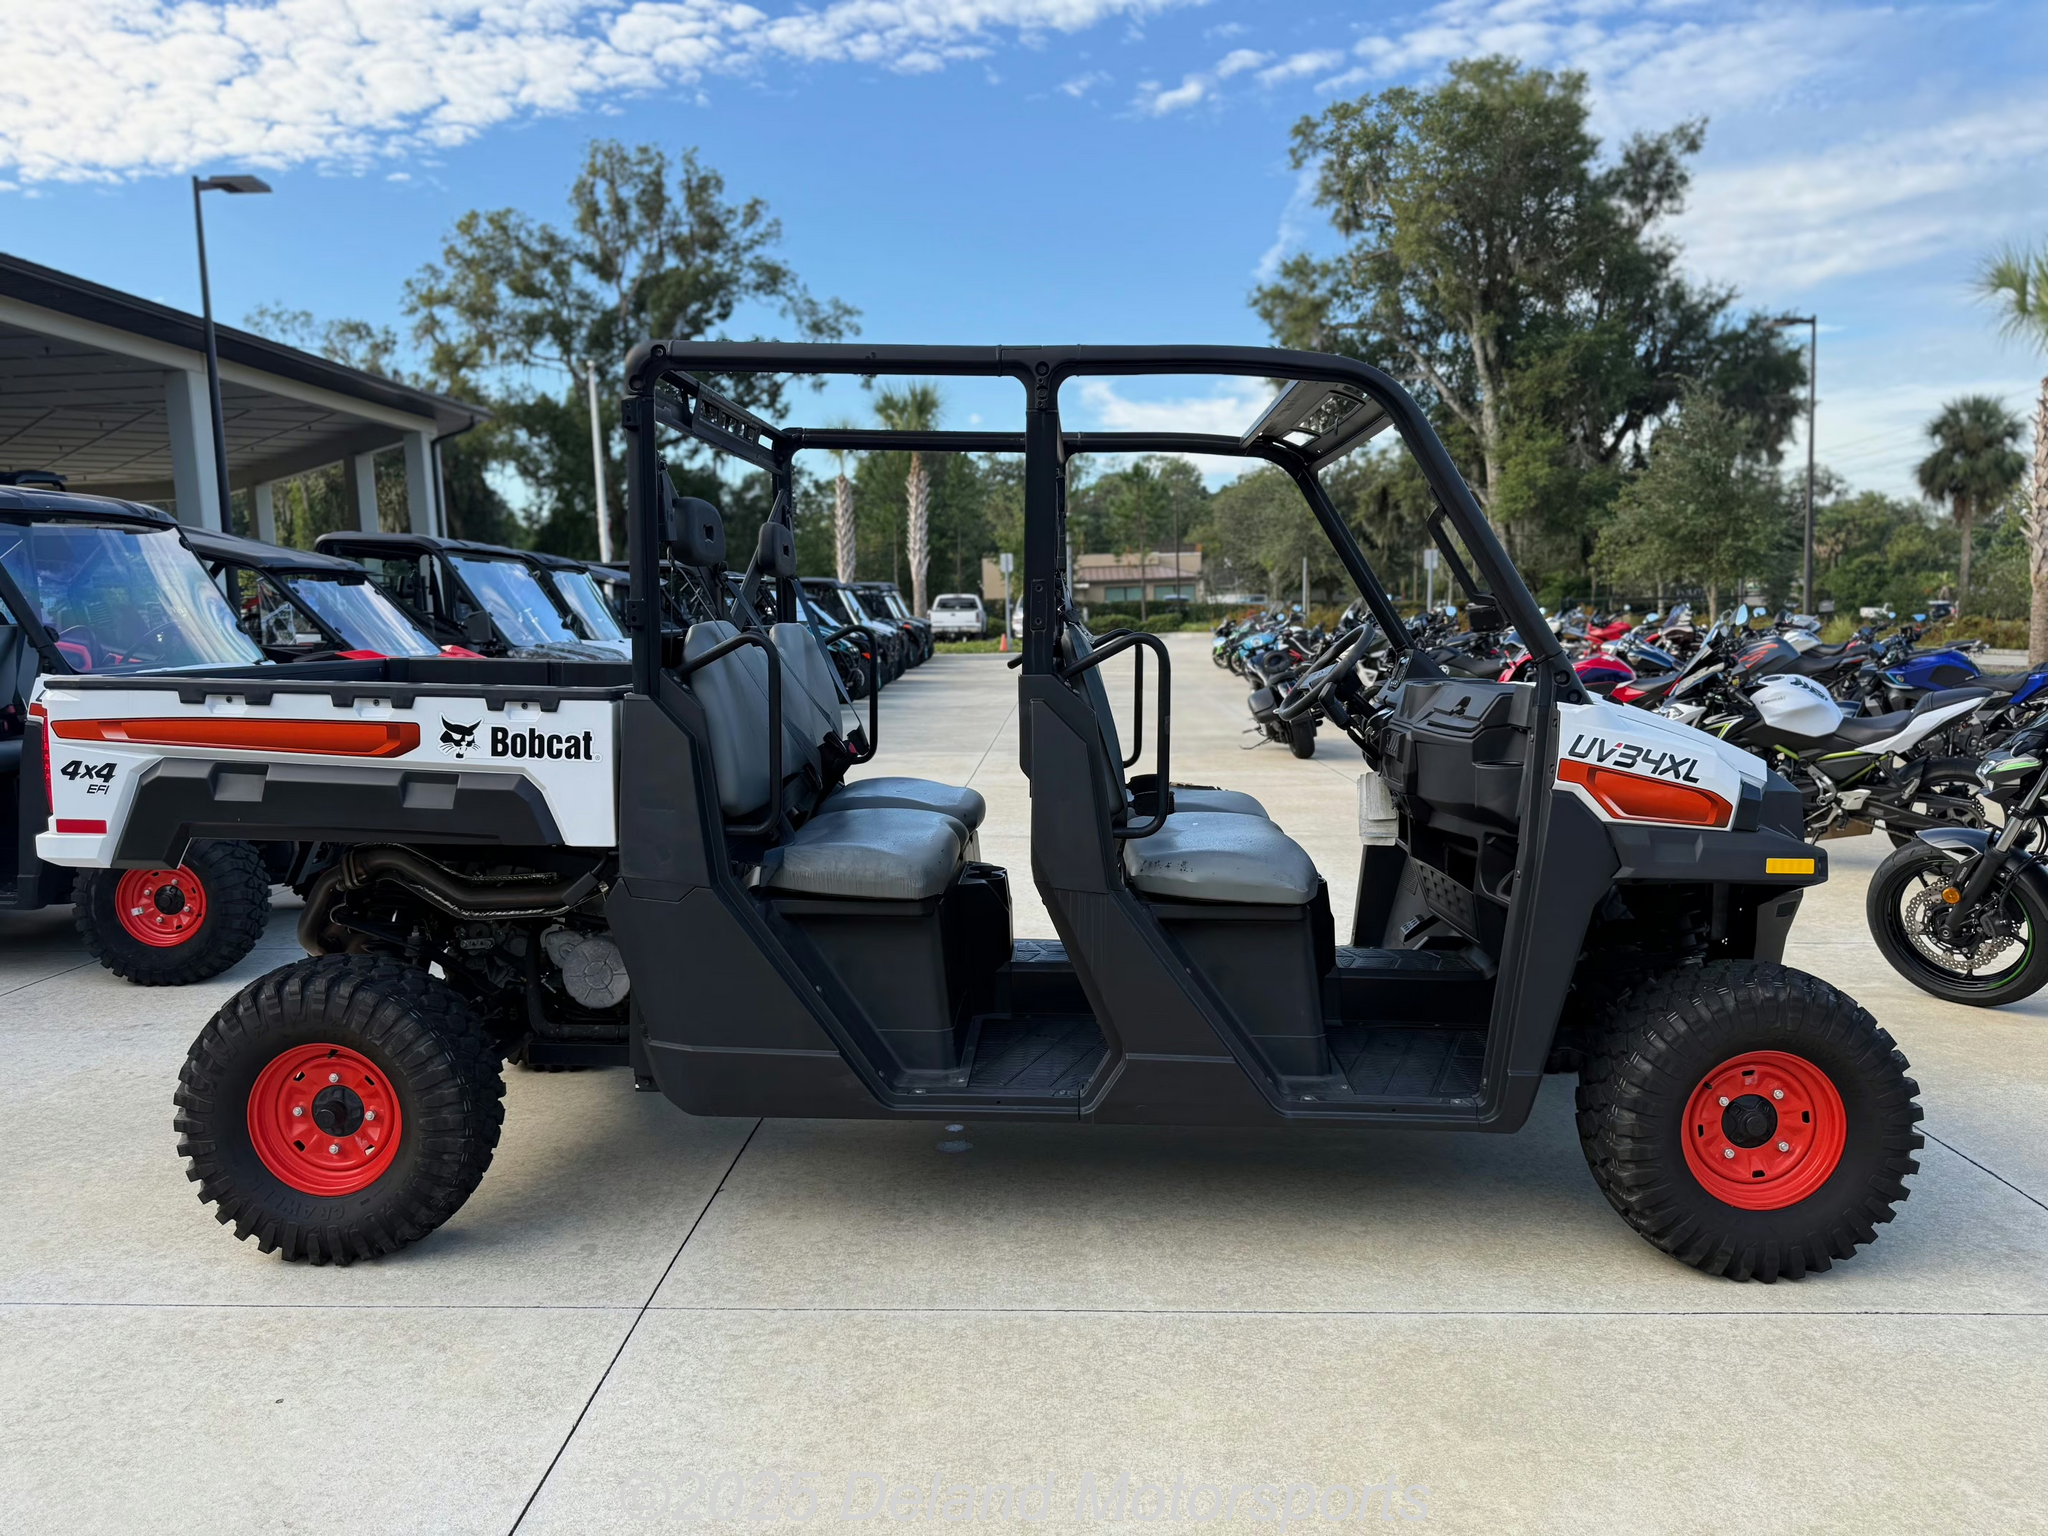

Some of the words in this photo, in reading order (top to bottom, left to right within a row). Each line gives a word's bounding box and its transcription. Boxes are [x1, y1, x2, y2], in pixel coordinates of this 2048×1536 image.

[1567, 733, 1700, 784] UV34XL
[60, 760, 118, 783] 4x4
[86, 784, 110, 795] EFI
